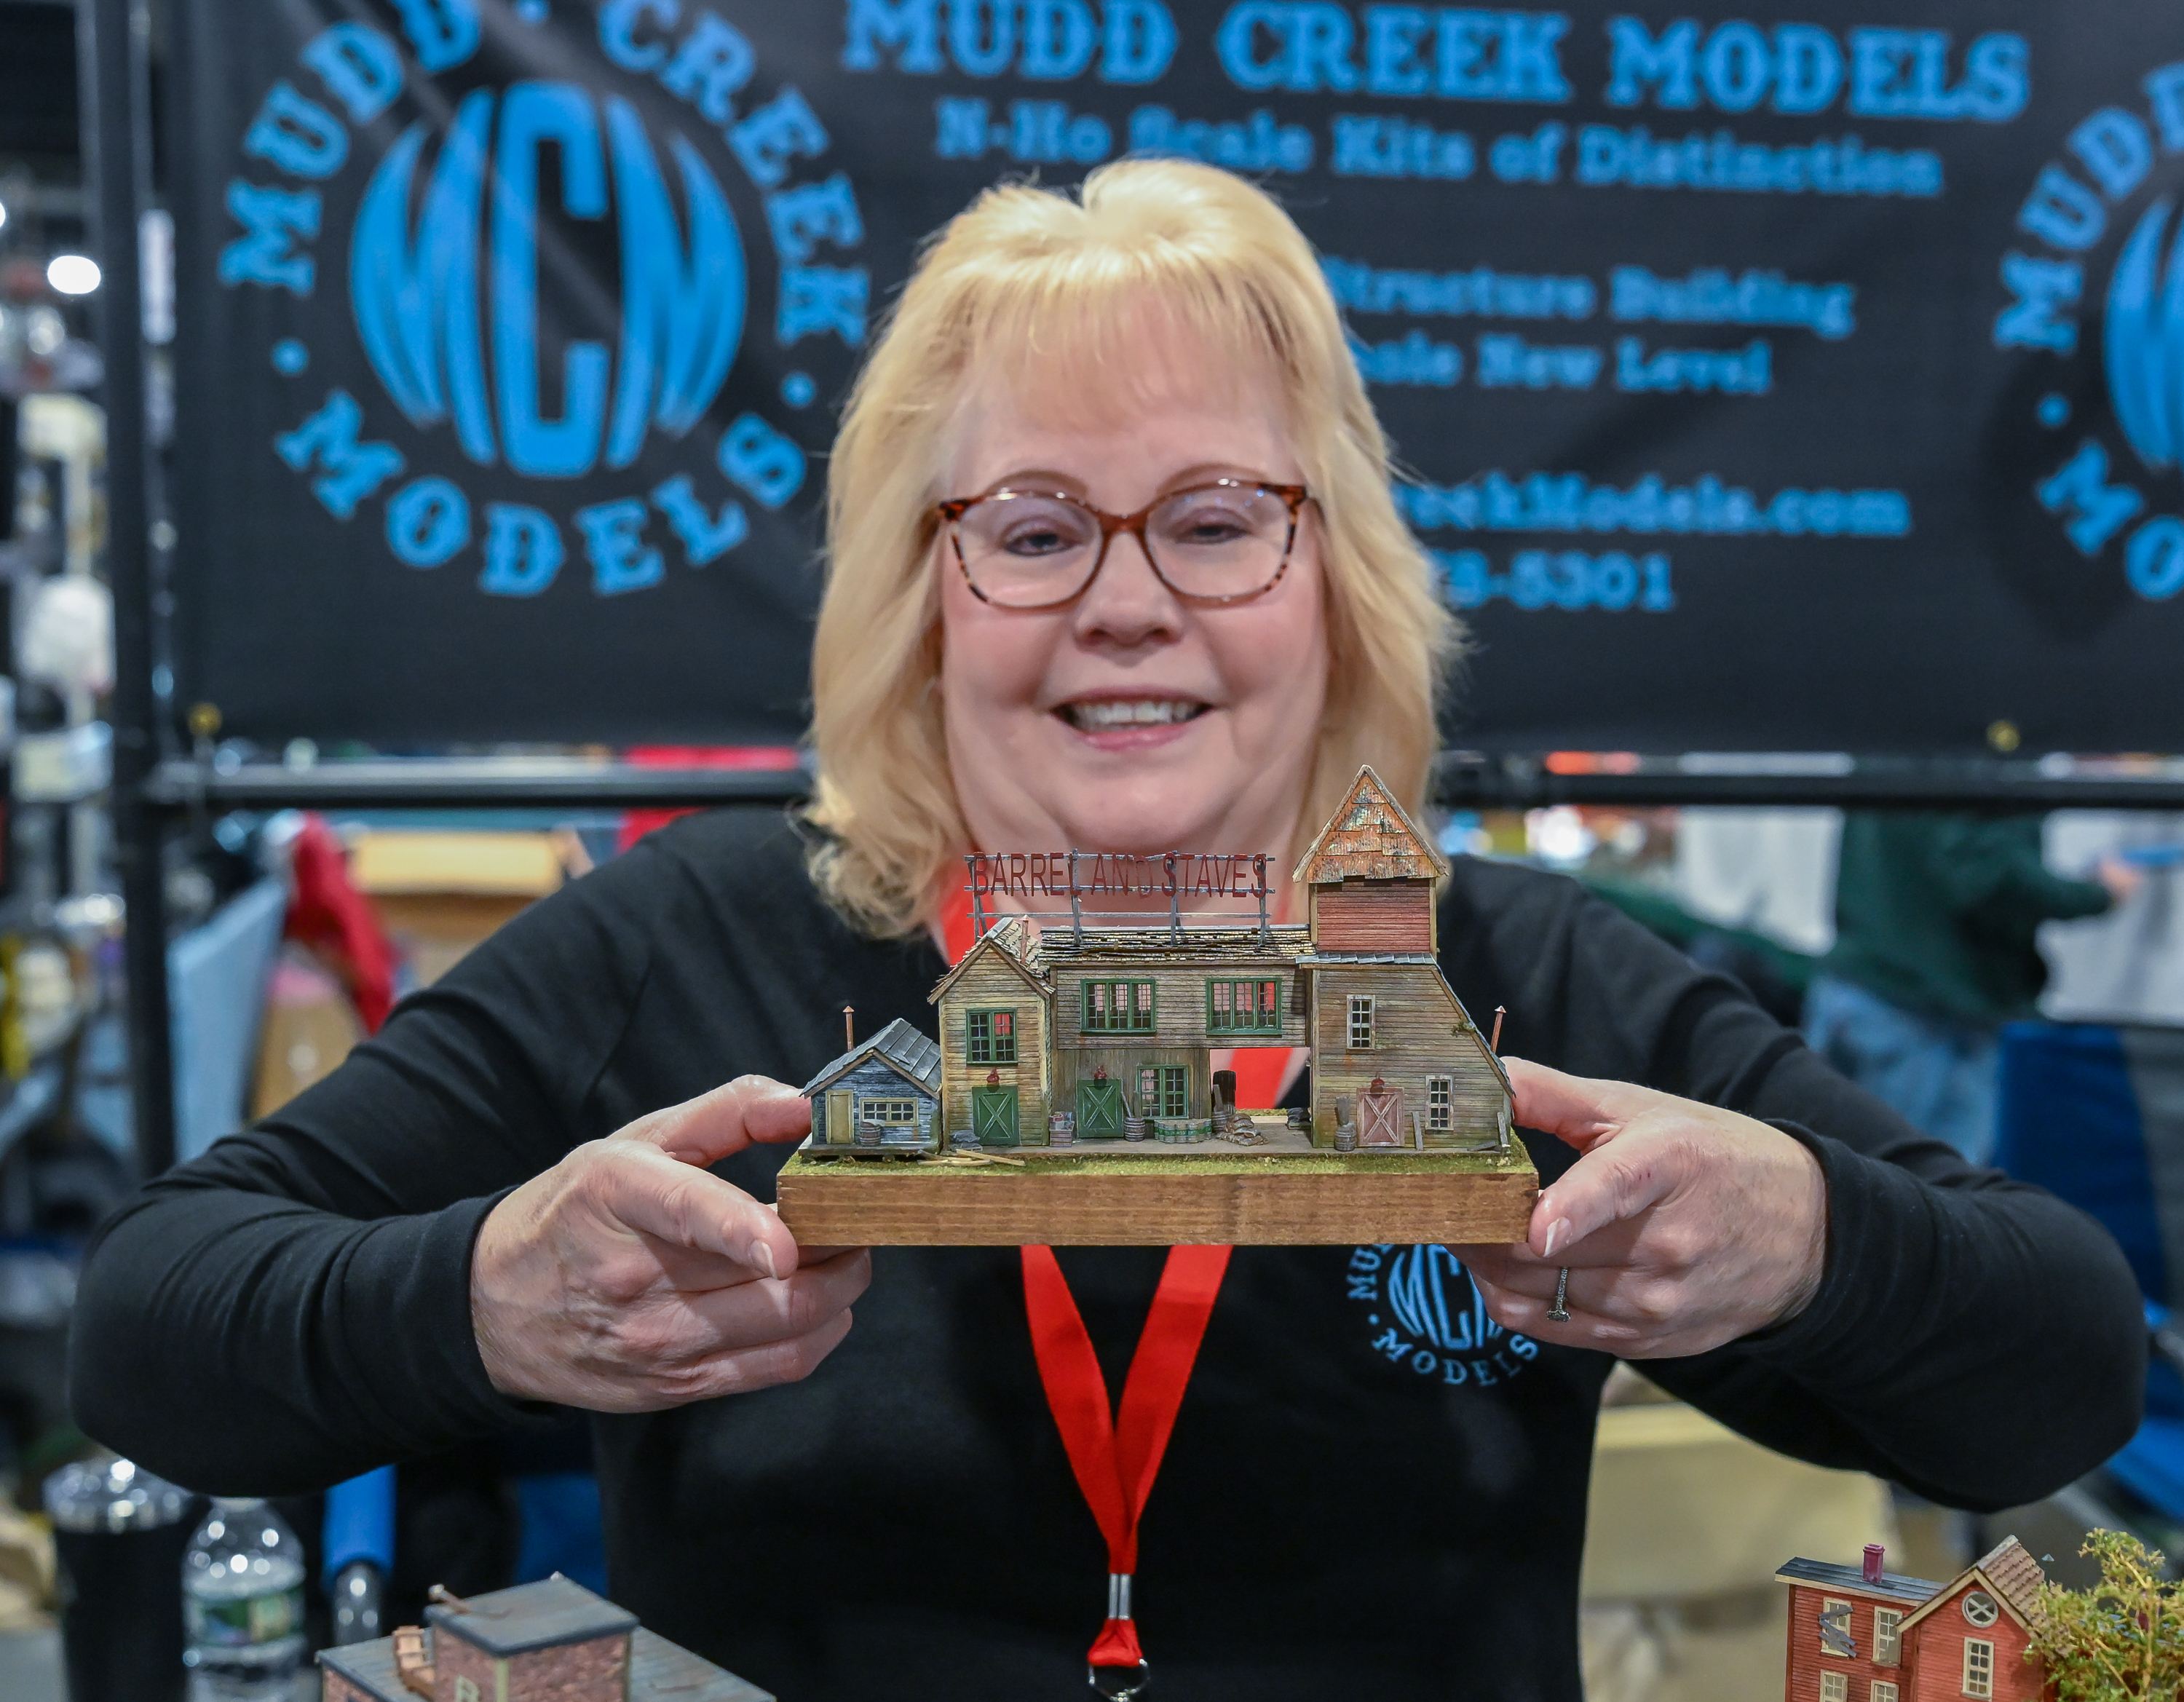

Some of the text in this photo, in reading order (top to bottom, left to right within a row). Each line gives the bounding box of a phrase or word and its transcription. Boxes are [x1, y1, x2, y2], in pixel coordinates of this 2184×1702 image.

[843, 0, 2031, 122] MUDD CREEK MODELS
[218, 0, 871, 347] MUDD CREEK
[1332, 114, 1476, 180] Kits
[1489, 121, 1567, 183] of
[1576, 124, 1944, 197] Distinction
[1610, 265, 1855, 340] Building
[1478, 333, 1603, 389] New
[1615, 336, 1771, 394] Level
[274, 389, 807, 597] MODELS
[1390, 471, 1911, 537] eekModels.com
[973, 851, 1083, 897] BARREL
[1161, 851, 1267, 898] STAVES
[1370, 1326, 1540, 1388] MODELS
